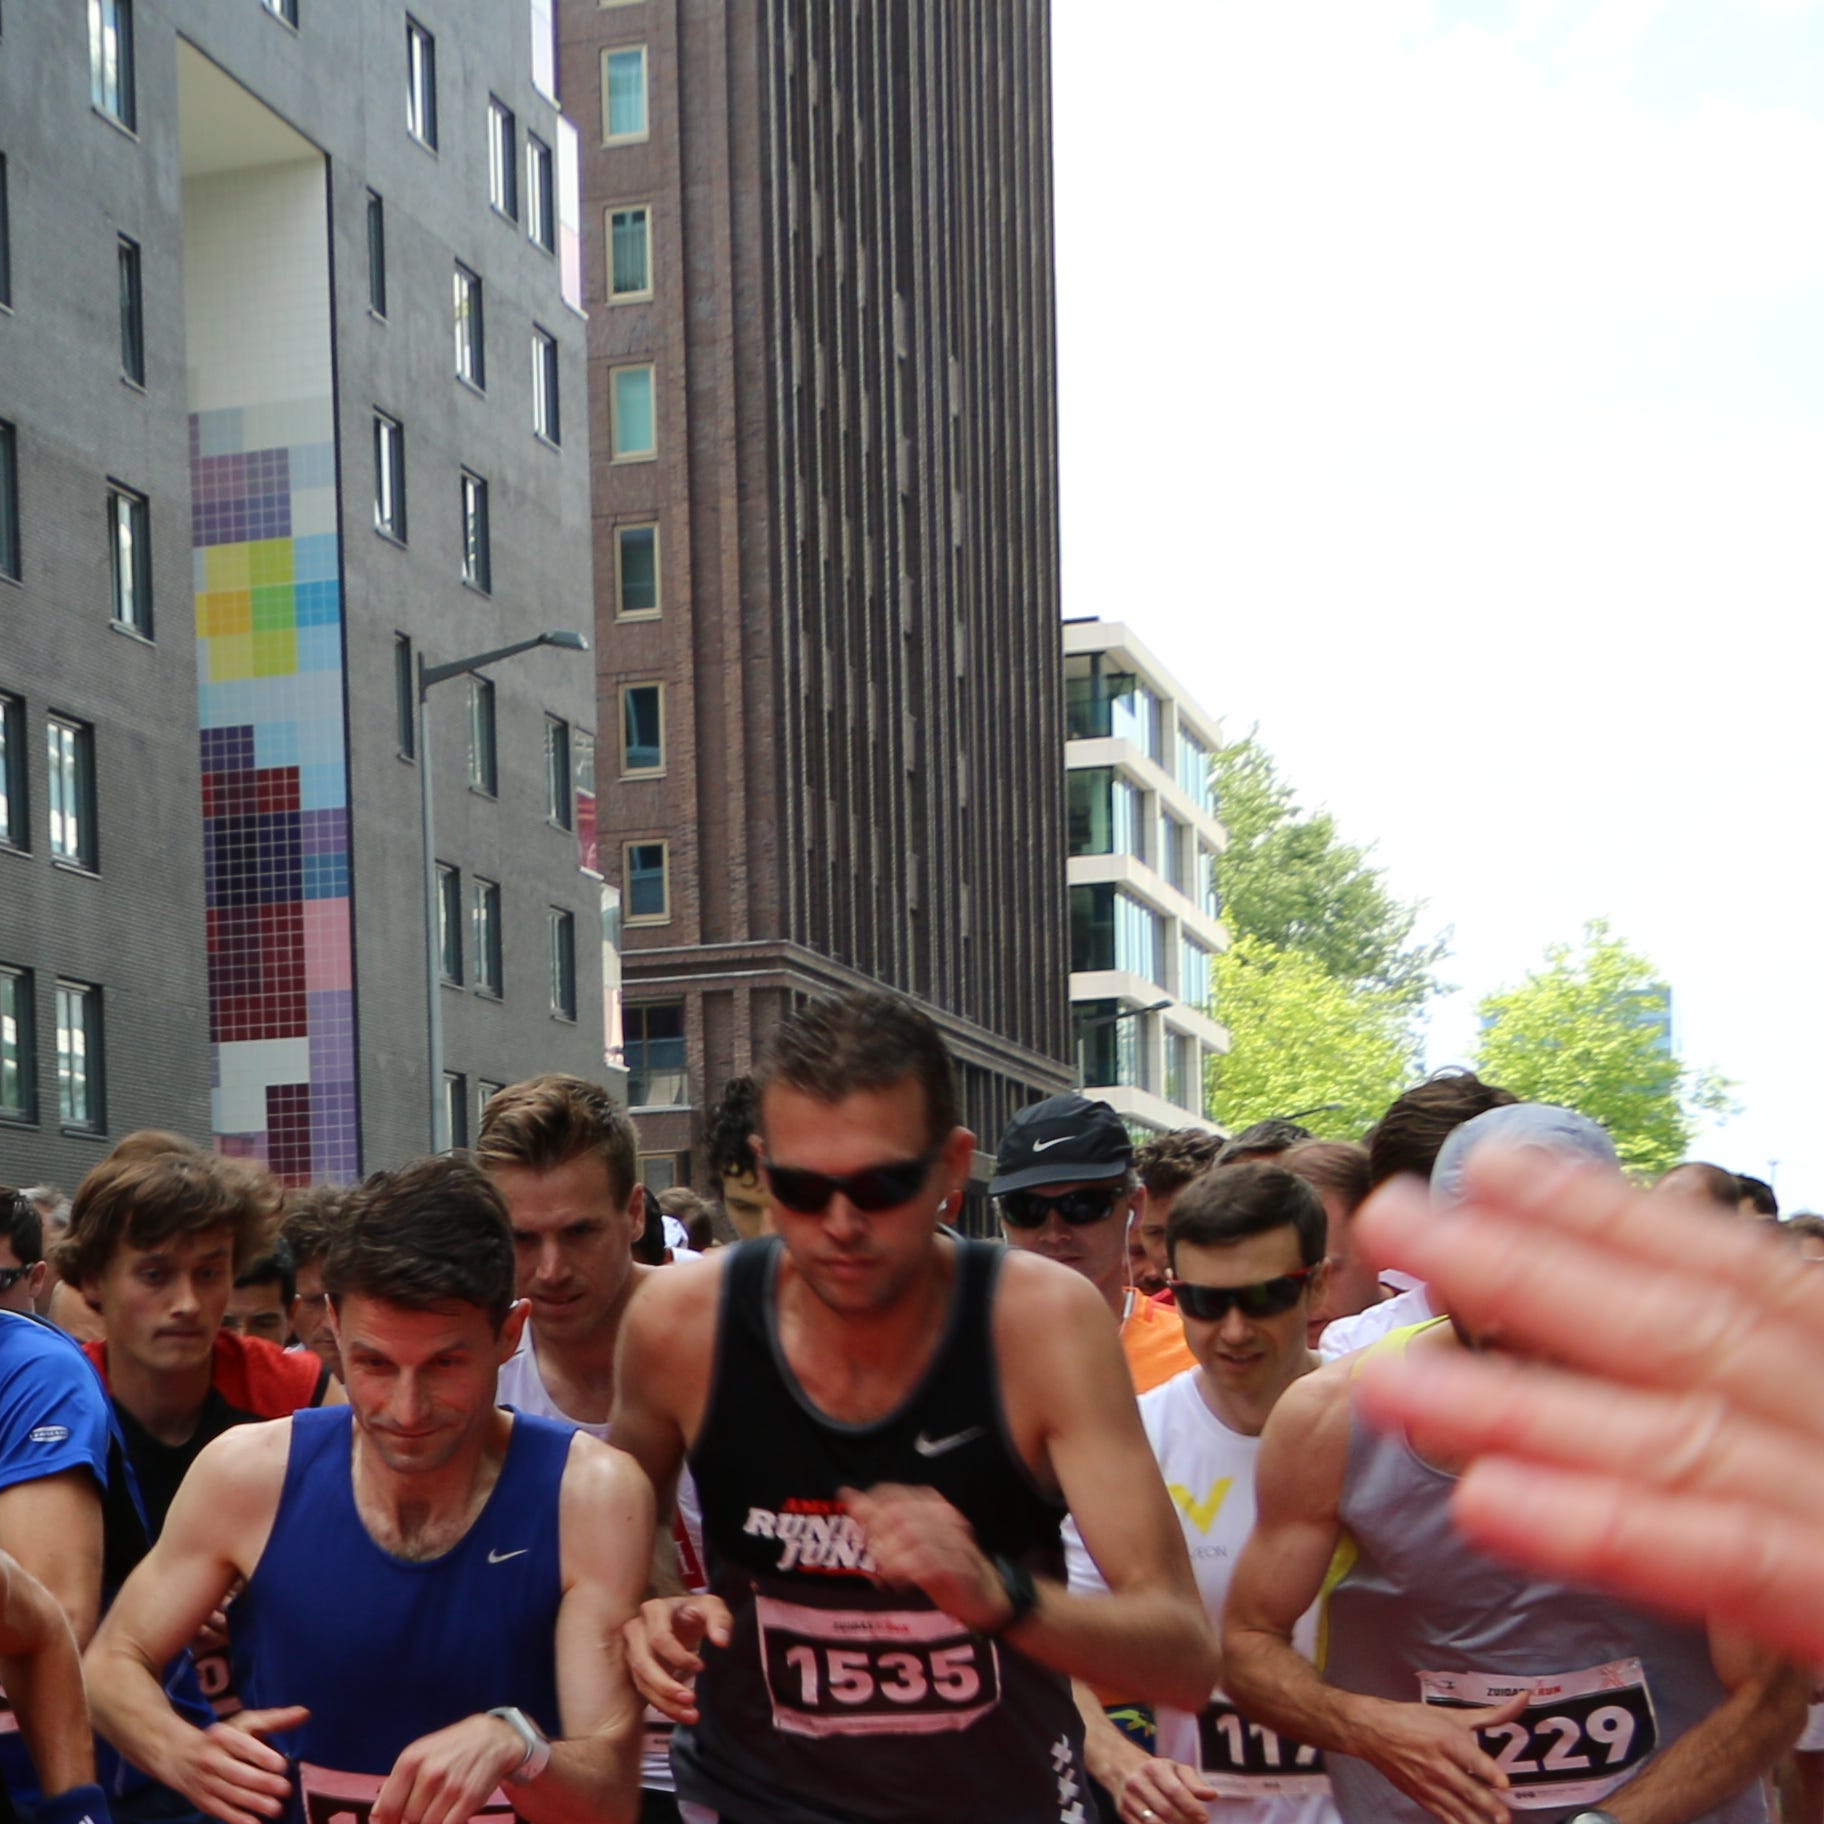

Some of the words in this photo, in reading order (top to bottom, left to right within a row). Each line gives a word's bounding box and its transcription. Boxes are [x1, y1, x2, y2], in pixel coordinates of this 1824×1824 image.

[743, 1507, 866, 1543] RUNN
[776, 1541, 877, 1572] JUN
[786, 1644, 980, 1705] 1535
[1484, 1705, 1636, 1774] 229
